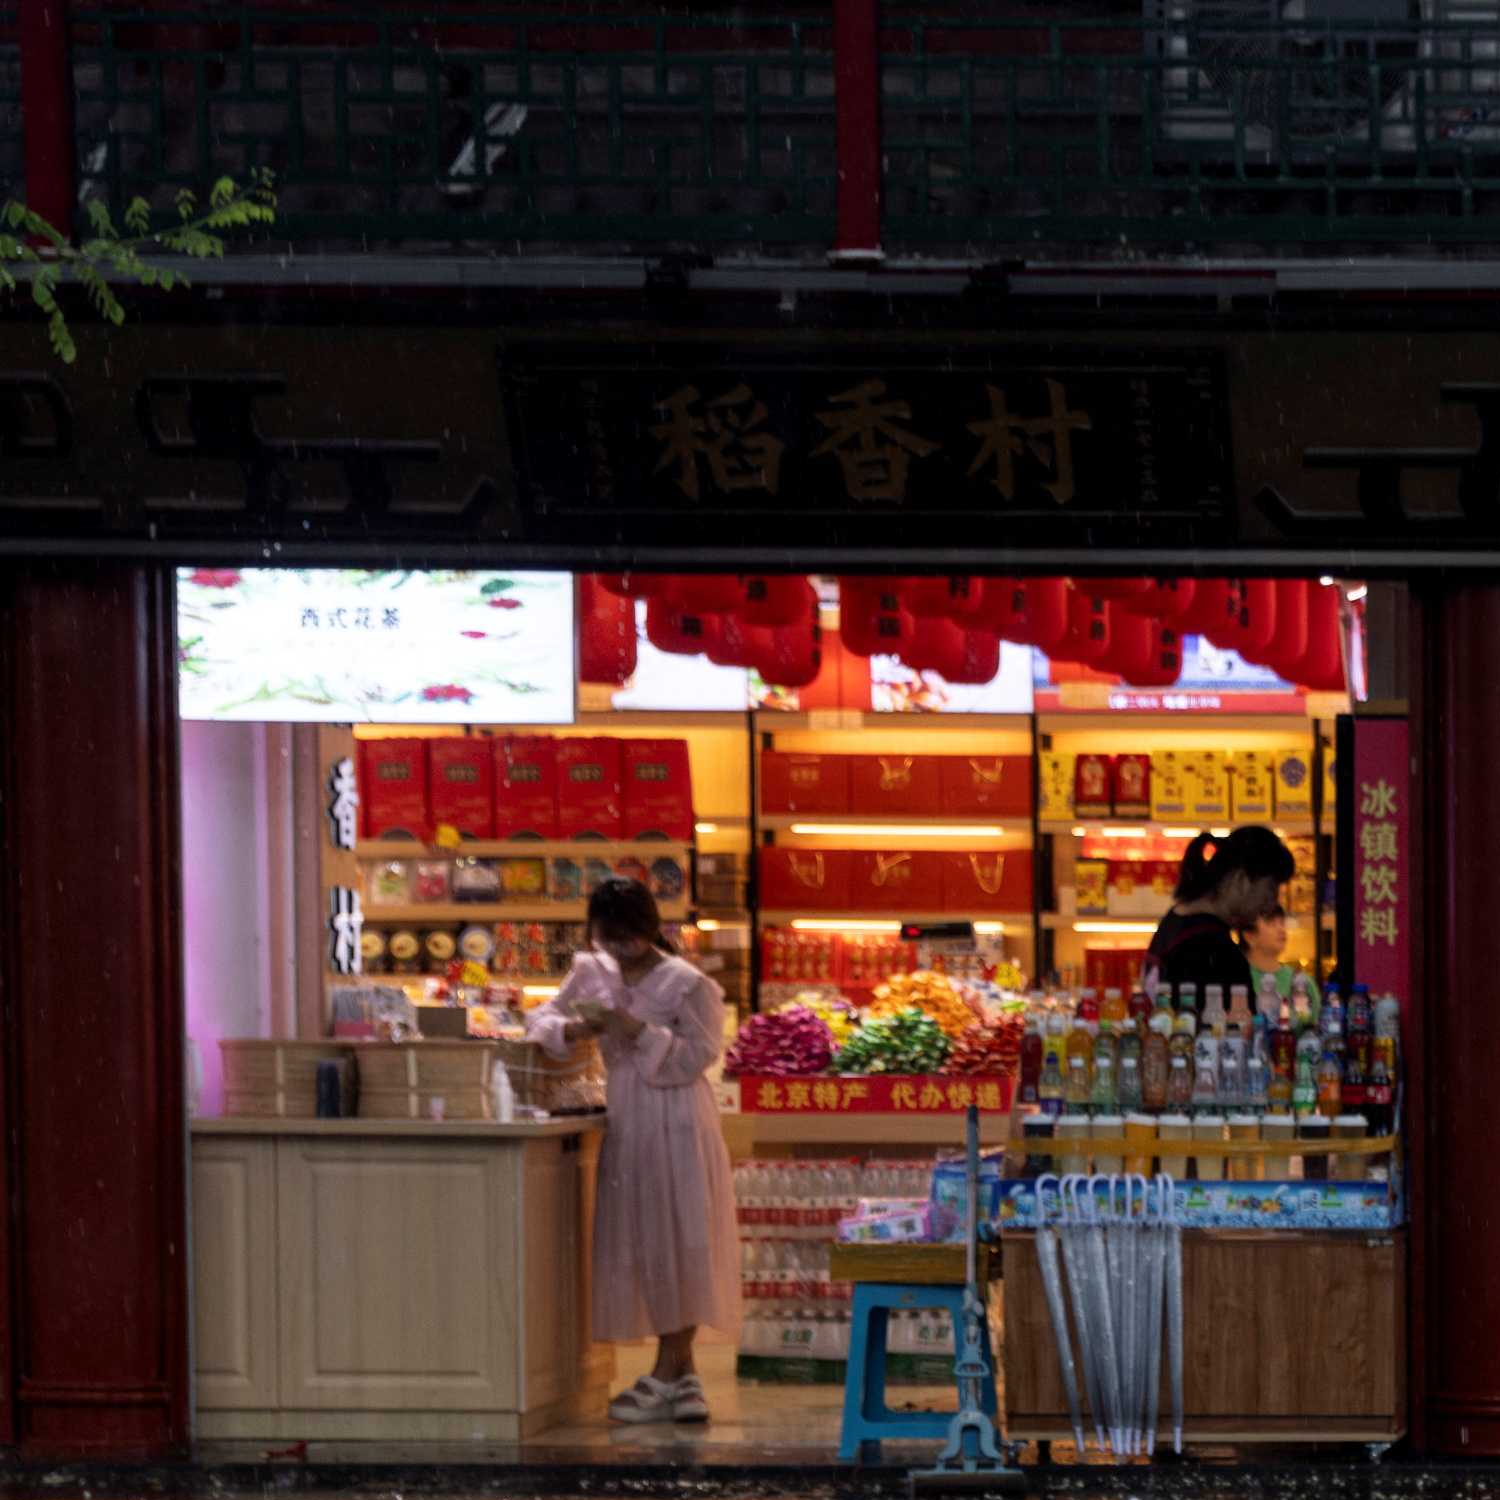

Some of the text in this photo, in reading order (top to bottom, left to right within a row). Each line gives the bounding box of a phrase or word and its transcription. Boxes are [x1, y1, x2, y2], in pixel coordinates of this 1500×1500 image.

[650, 374, 1094, 505] 稻香村
[1360, 779, 1398, 946] 冰镇饮料
[756, 1081, 1001, 1109] 北京特产 代办快递
